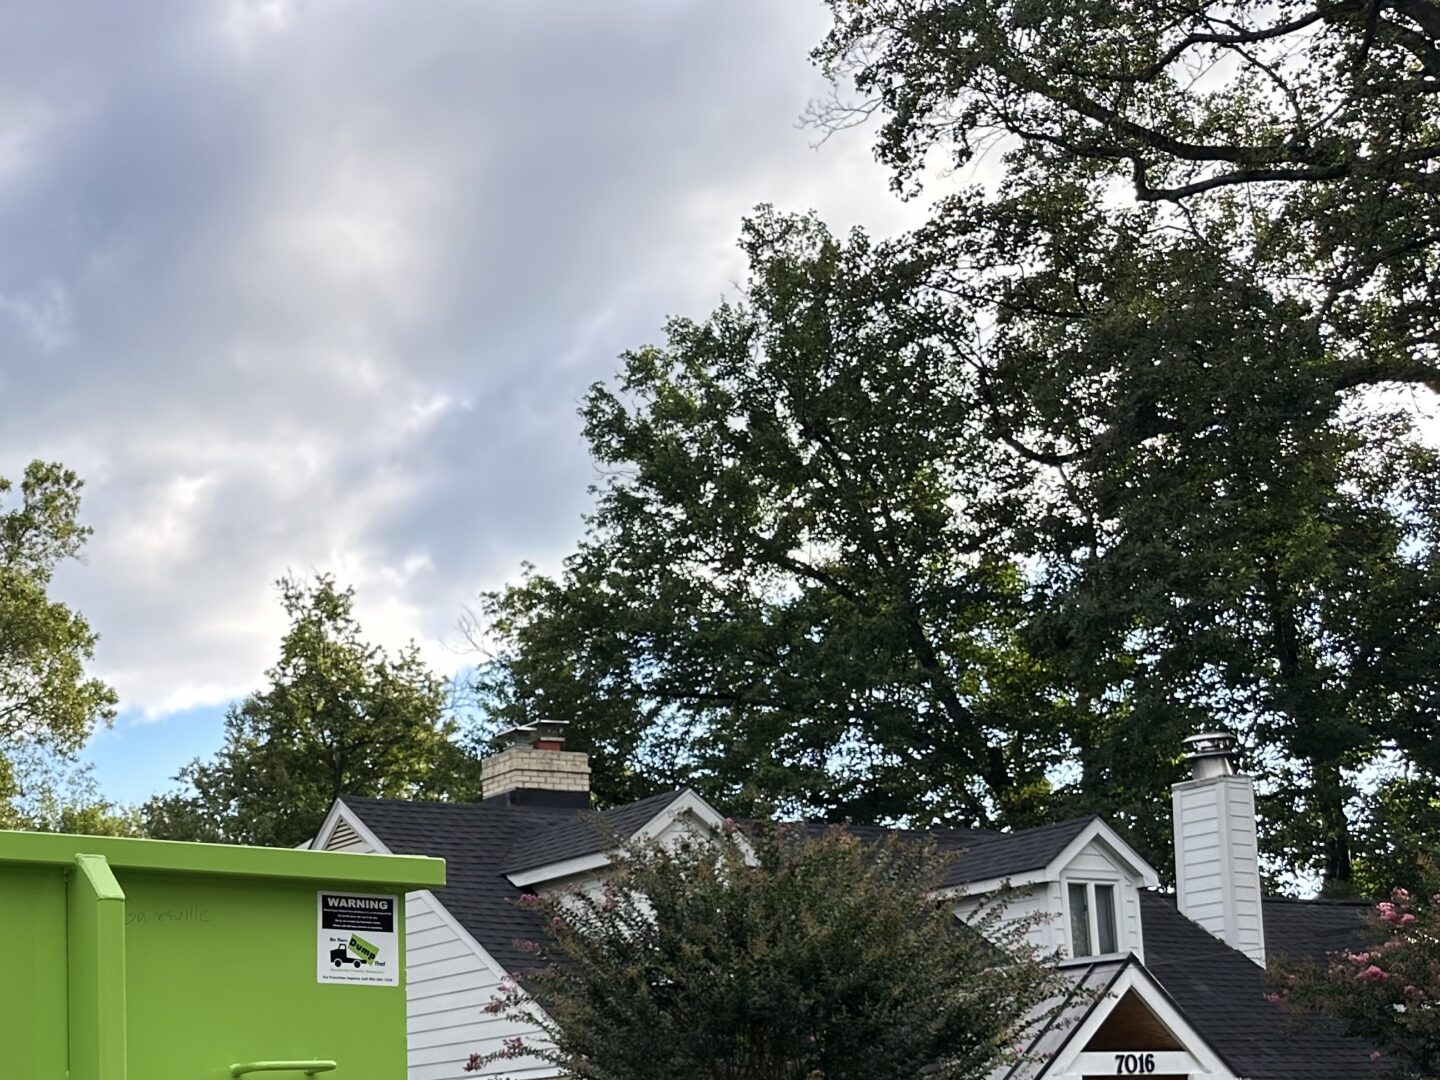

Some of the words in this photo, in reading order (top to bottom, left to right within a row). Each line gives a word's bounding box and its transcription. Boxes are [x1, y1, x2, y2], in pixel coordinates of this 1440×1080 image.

[327, 897, 388, 910] WARNING
[348, 937, 376, 960] Dump
[1115, 1053, 1155, 1075] 7016
